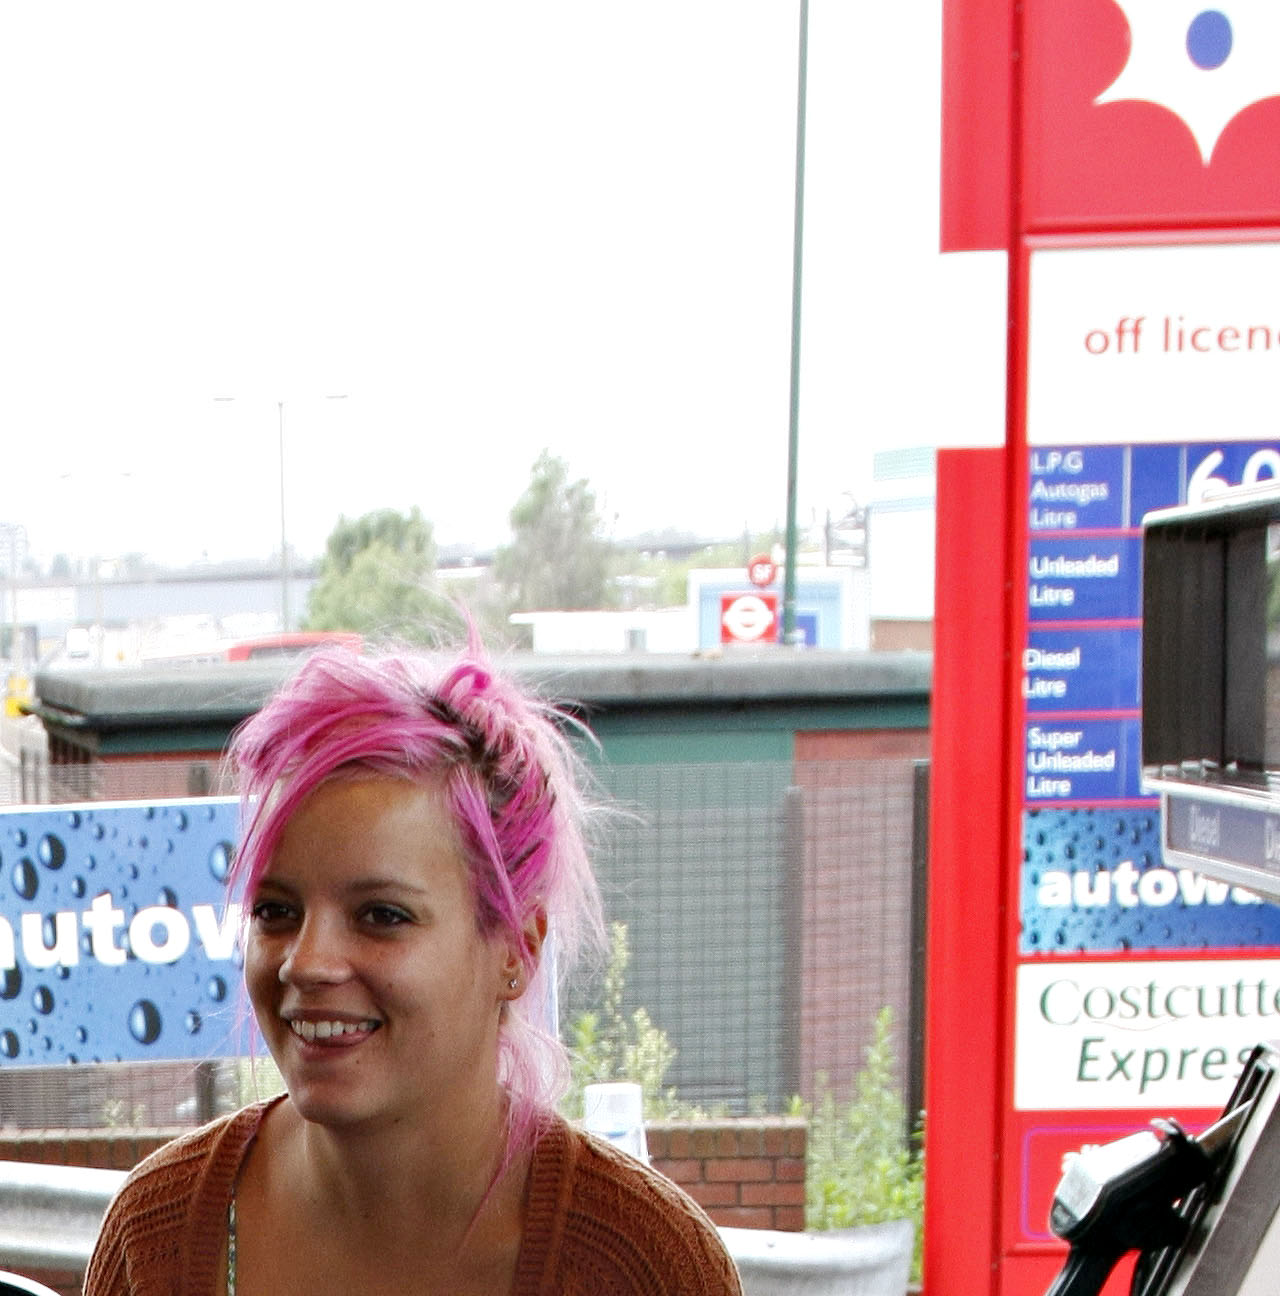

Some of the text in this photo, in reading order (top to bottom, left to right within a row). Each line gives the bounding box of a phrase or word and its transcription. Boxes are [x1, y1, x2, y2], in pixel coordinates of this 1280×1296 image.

[1084, 315, 1280, 355] off licen
[1031, 480, 1109, 506] Autogas
[1031, 509, 1077, 529] Litre
[1030, 555, 1120, 578] Unleaded
[1030, 585, 1075, 606] Litre
[1023, 647, 1081, 670] Diesel
[1023, 678, 1067, 697] Litre
[1027, 727, 1083, 749] Super
[1028, 751, 1116, 772] Unleaded
[1027, 776, 1072, 797] Litre
[1038, 977, 1280, 1027] Costcutt
